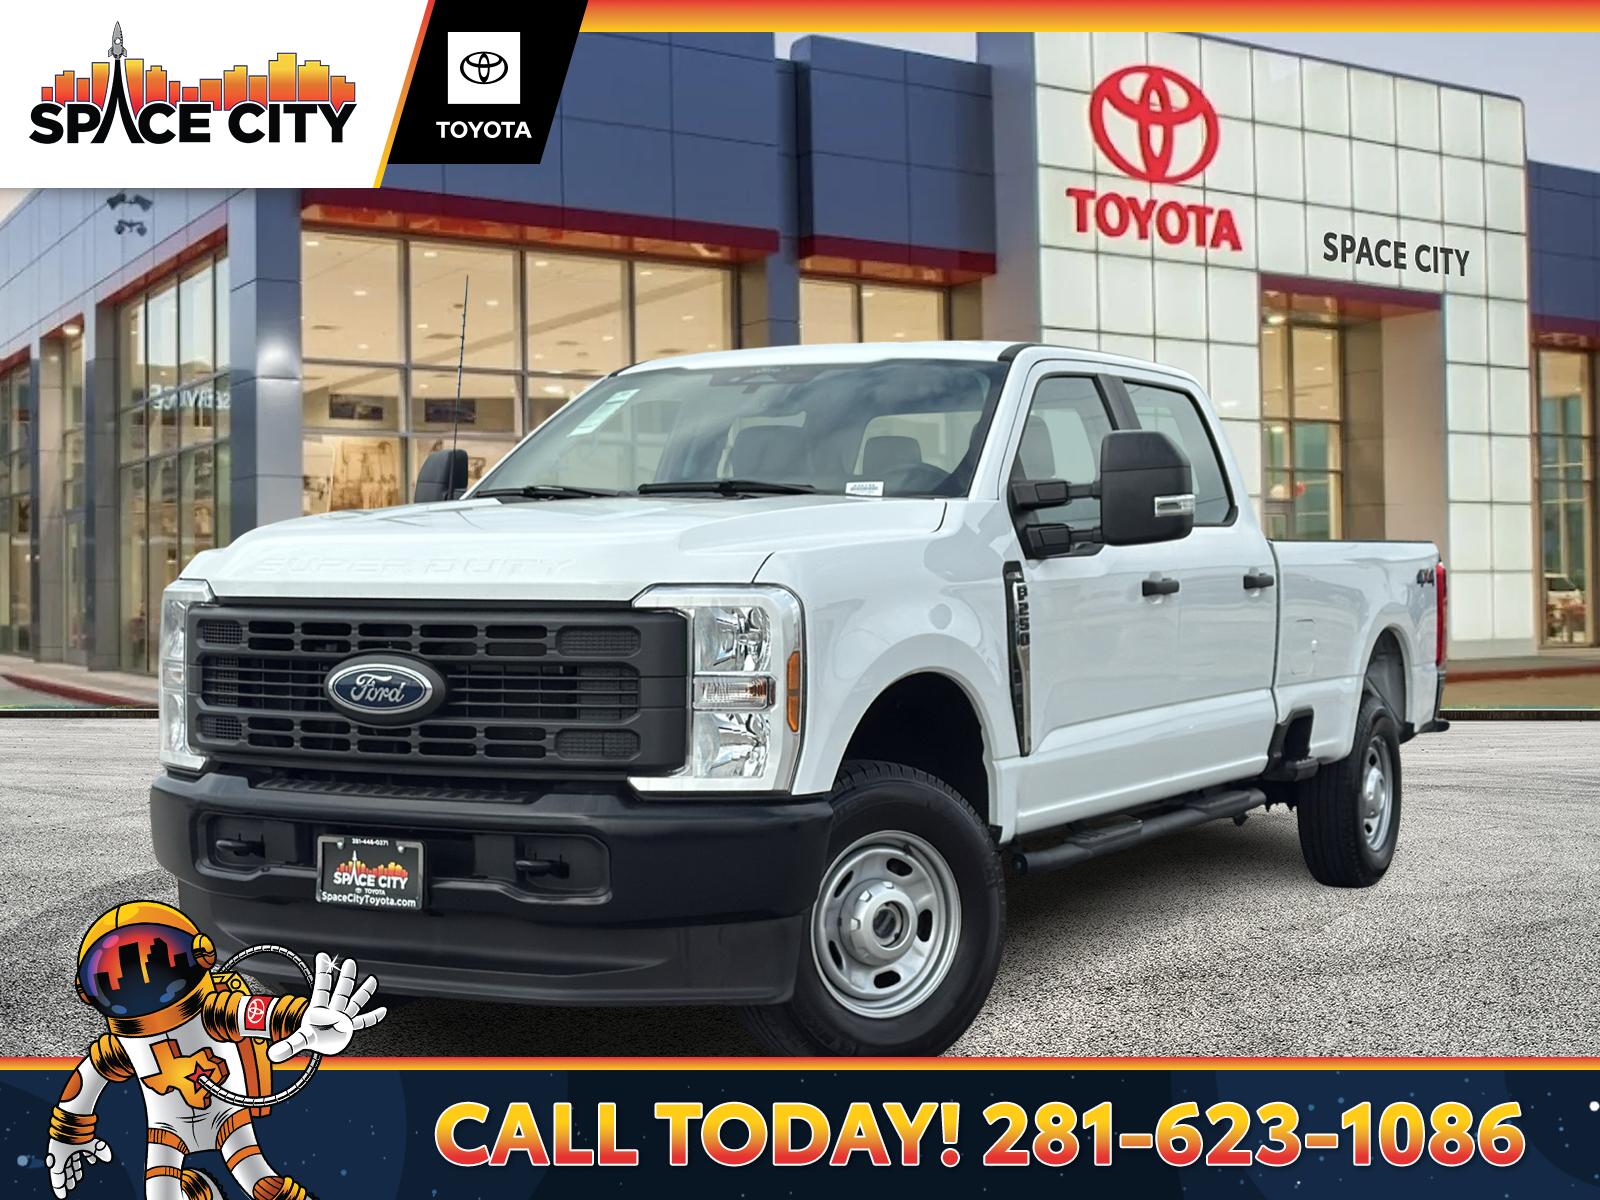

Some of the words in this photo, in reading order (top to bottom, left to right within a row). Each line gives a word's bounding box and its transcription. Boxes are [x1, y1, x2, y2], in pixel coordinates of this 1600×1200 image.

[1066, 187, 1243, 251] TOYOTA
[1323, 232, 1407, 269] SPACE
[1414, 245, 1470, 277] CITY
[253, 556, 408, 574] SUPER
[423, 556, 576, 575] DUTY
[350, 673, 406, 702] Ford
[364, 887, 386, 895] TOYOTA
[378, 874, 409, 890] CITY
[321, 891, 416, 907] SpaceCityToyota.com
